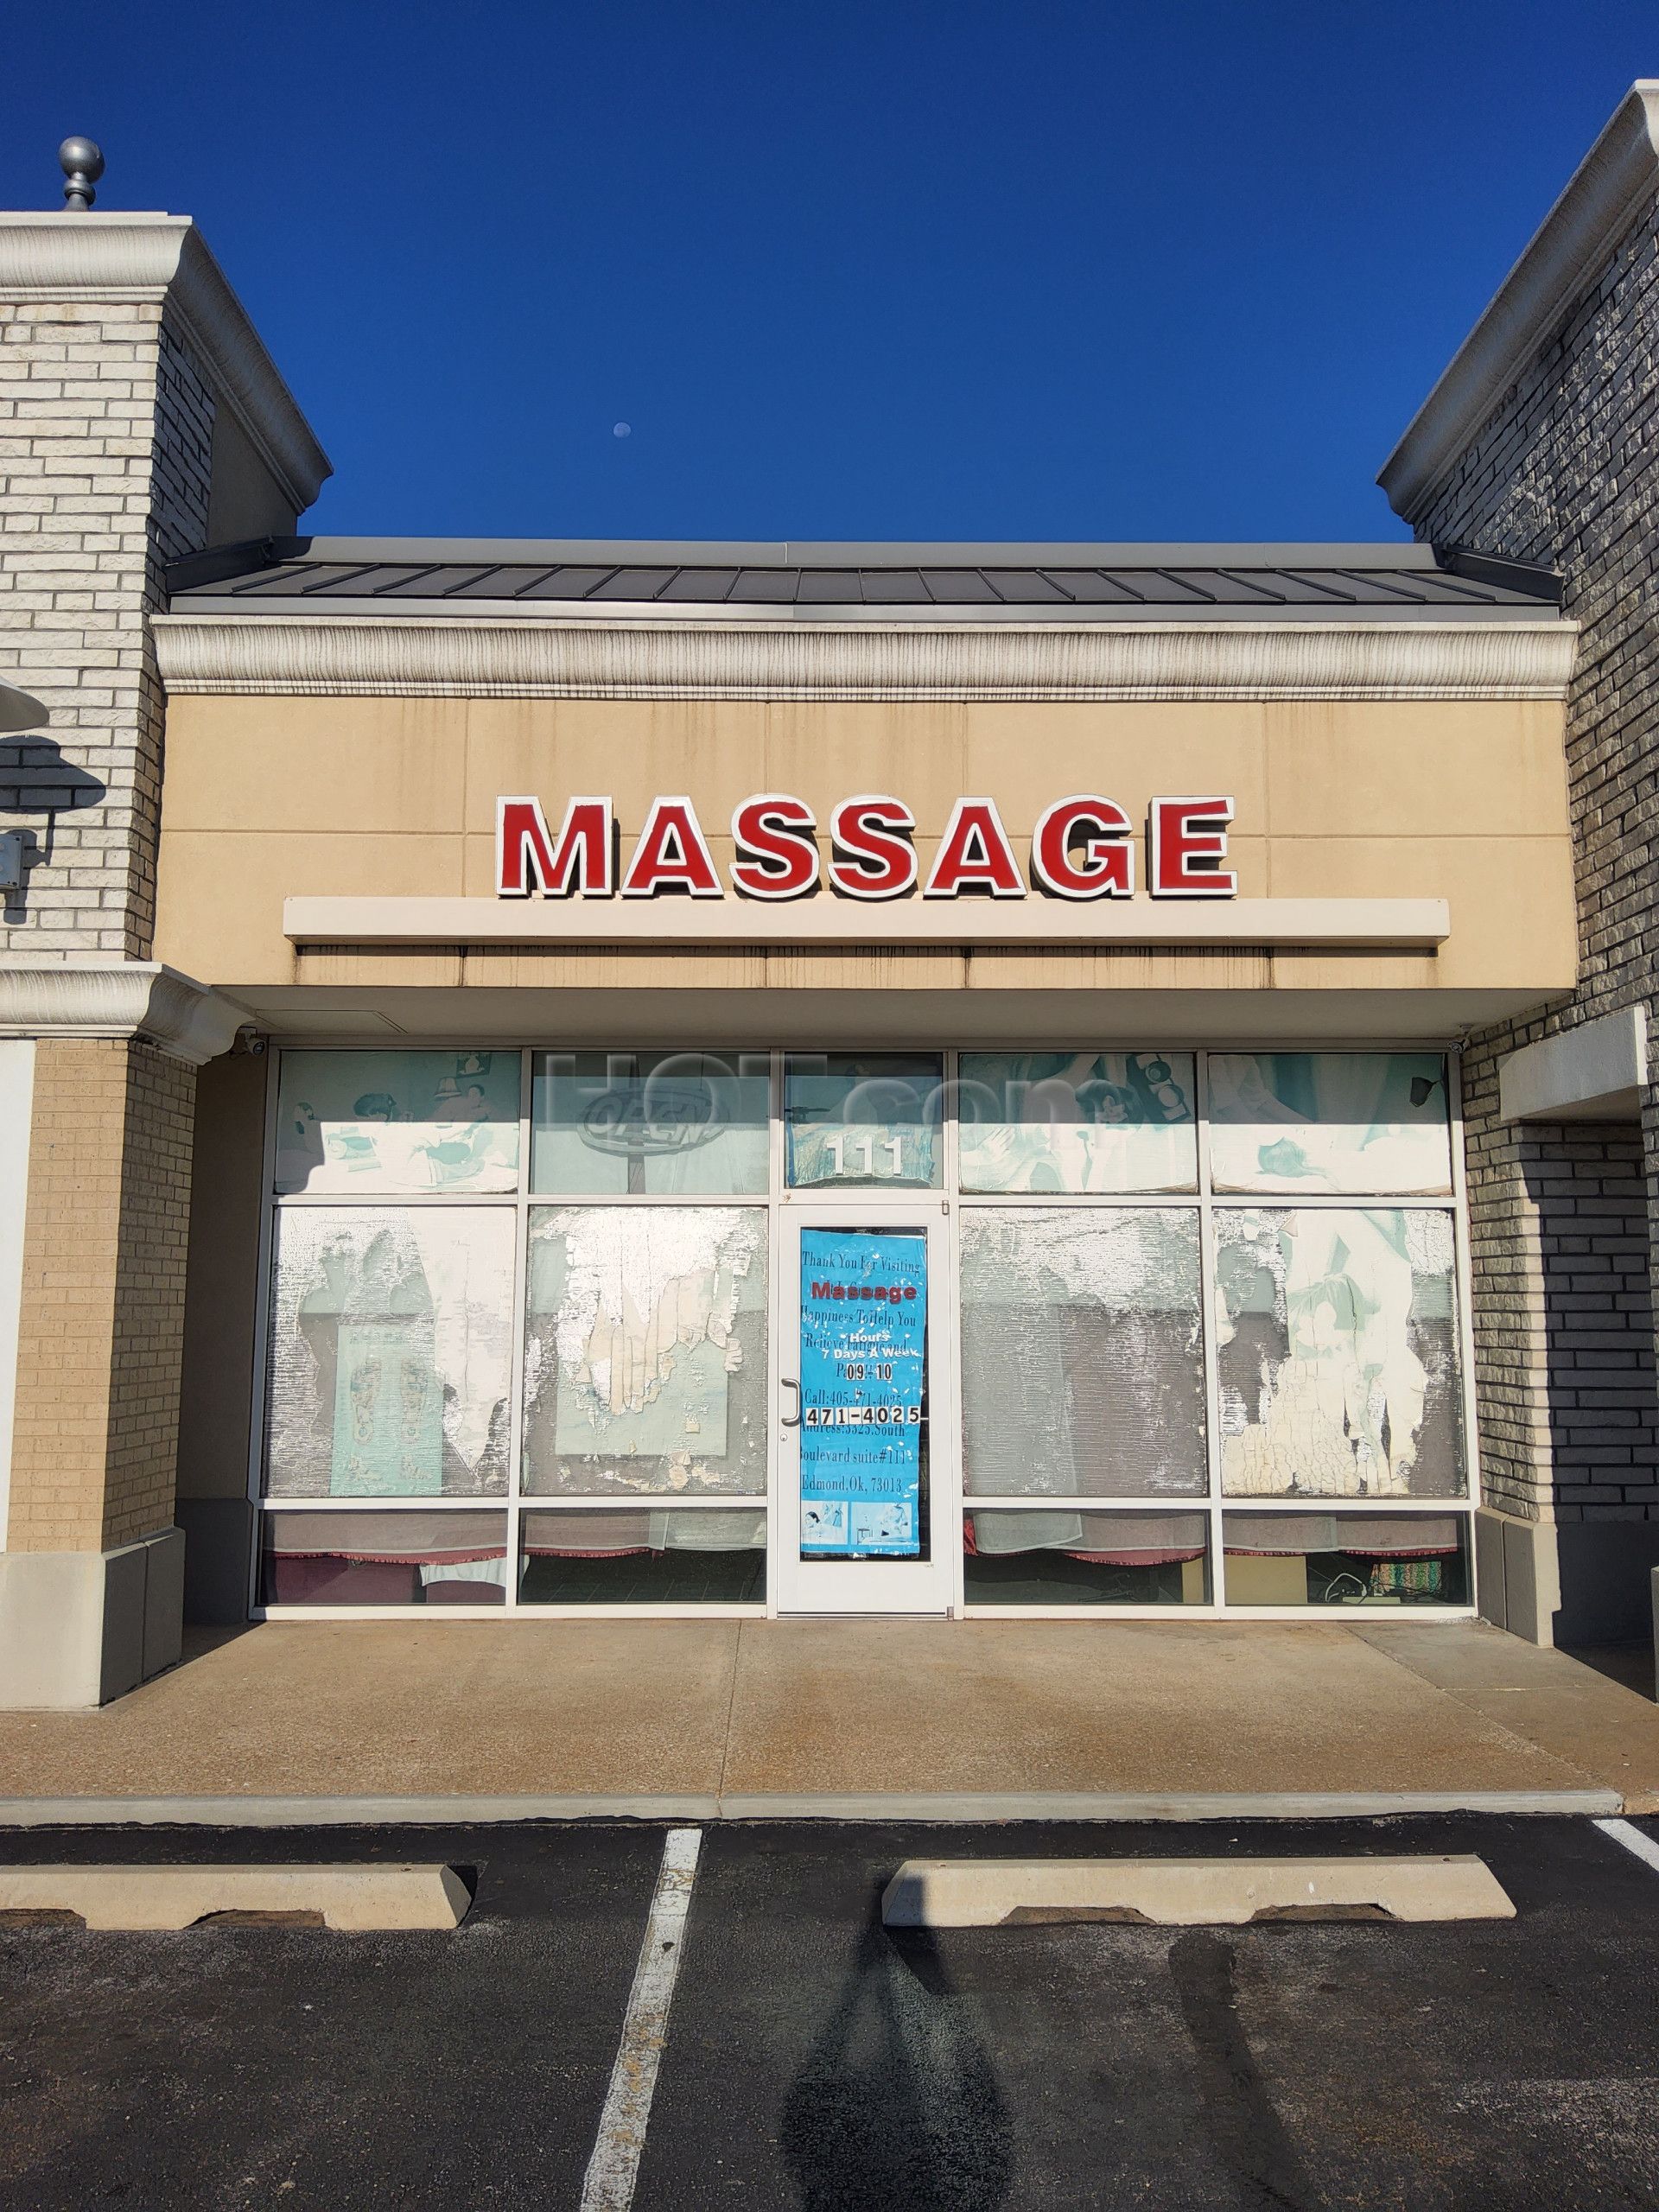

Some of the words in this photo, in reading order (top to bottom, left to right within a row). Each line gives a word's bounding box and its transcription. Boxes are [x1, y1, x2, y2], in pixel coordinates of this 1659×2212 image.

[497, 793, 1238, 900] MASSAGE
[827, 1136, 902, 1175] 111
[802, 1250, 835, 1268] Thank
[838, 1253, 857, 1269] You
[880, 1256, 920, 1277] Visiting
[811, 1281, 917, 1305] Massage
[898, 1311, 916, 1326] You
[849, 1332, 889, 1343] Hours
[822, 1349, 830, 1359] 7
[834, 1349, 865, 1361] Days
[869, 1347, 879, 1358] A
[882, 1348, 919, 1358] Week
[807, 1407, 919, 1425] 471-4025
[871, 1477, 902, 1493] 73013
